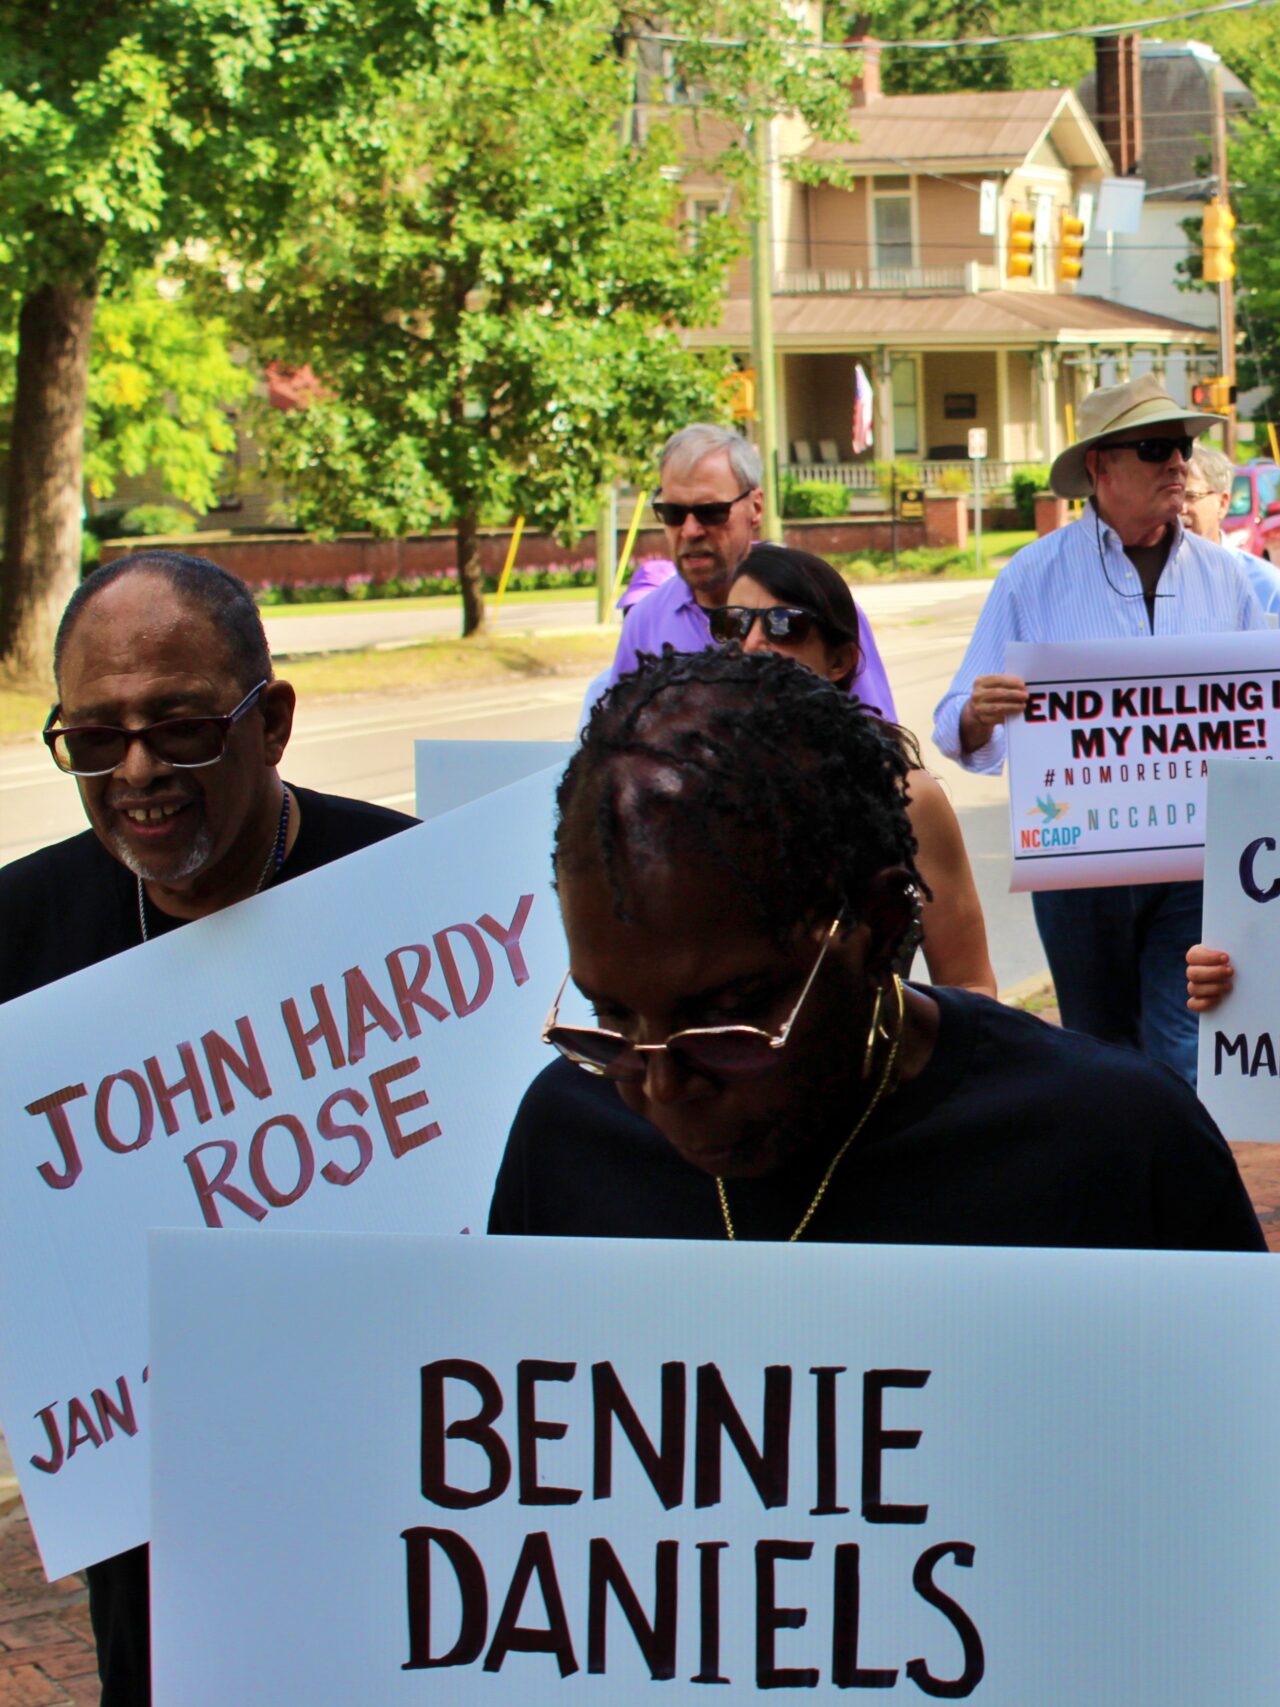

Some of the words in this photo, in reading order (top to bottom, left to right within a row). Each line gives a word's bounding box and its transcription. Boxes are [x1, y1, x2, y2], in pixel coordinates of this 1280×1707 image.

[1023, 690, 1101, 722] END
[1111, 680, 1263, 718] KILLING
[1070, 726, 1136, 759] MY
[1142, 719, 1268, 755] NAME!
[1020, 826, 1082, 849] NCCADP
[25, 1015, 272, 1190] JOHN
[280, 893, 535, 1080] HARDY
[184, 1056, 442, 1229] ROSE
[30, 1375, 139, 1475] JAN
[420, 1358, 932, 1525] BENNIE
[400, 1526, 985, 1699] DANIELS
